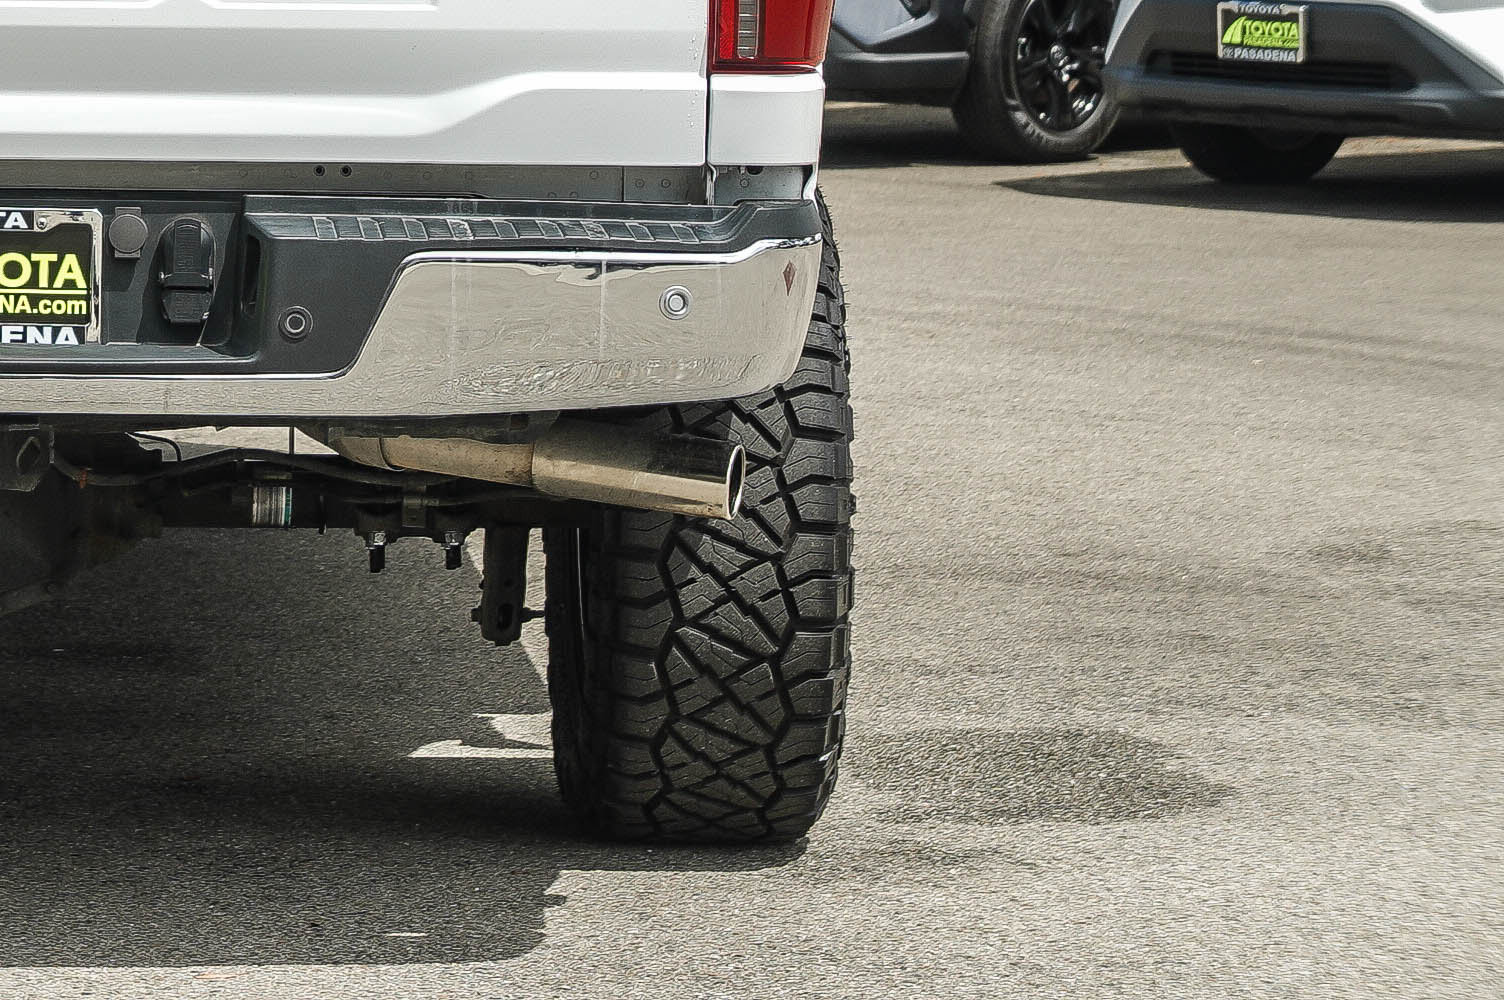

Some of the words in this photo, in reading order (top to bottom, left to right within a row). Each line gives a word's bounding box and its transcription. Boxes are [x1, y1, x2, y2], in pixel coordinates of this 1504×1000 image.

[1239, 3, 1281, 15] TOYOTA
[1243, 20, 1299, 38] TOYOTA
[1233, 47, 1297, 62] PASADENA
